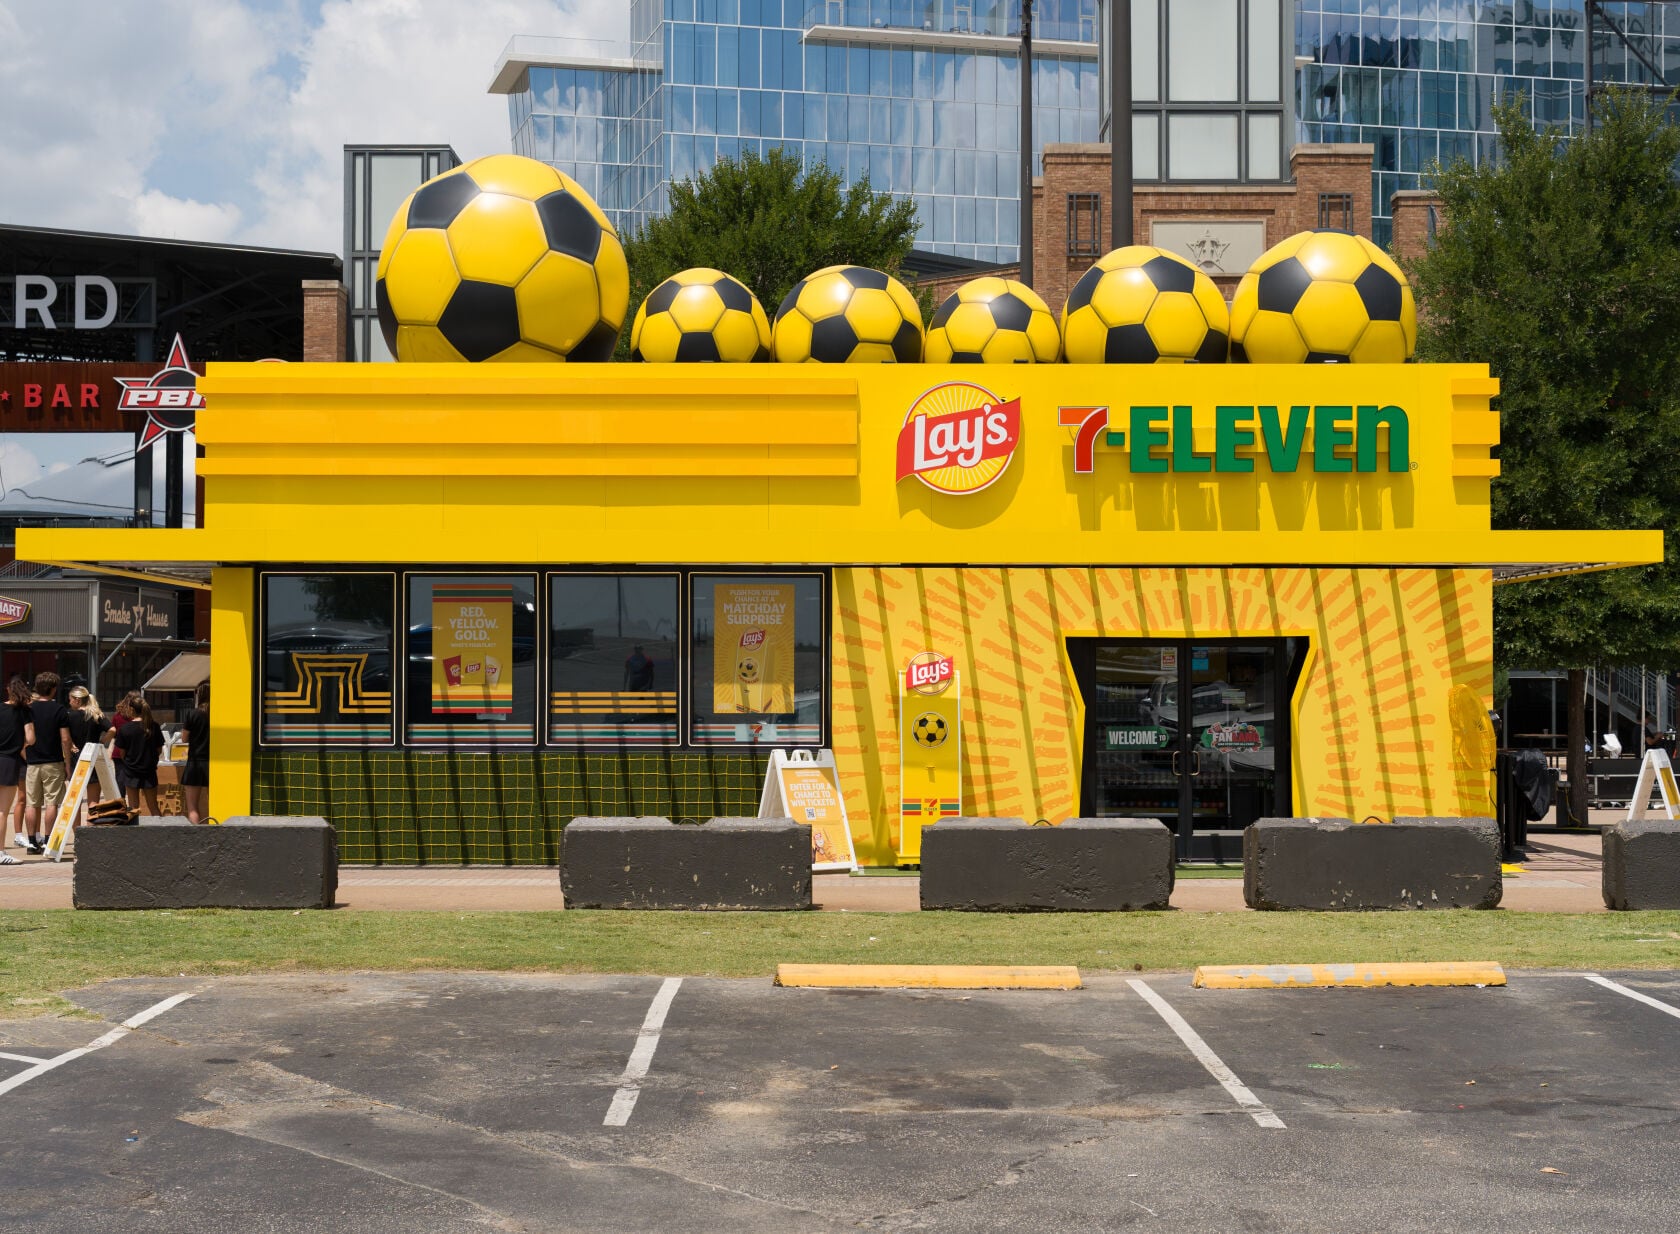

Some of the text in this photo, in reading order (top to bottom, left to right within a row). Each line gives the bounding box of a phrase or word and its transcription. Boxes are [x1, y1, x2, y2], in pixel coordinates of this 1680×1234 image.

[23, 383, 100, 408] BAR
[913, 403, 1008, 470] Lay's
[460, 606, 487, 618] RED.
[723, 603, 786, 614] MATCHDAY
[449, 618, 499, 629] YELLOW.
[727, 614, 784, 625] SURPRISE
[455, 629, 490, 641] GOLD.
[742, 631, 763, 646] Lay's
[912, 660, 949, 685] Lay's
[1108, 731, 1167, 745] WELCOME TO
